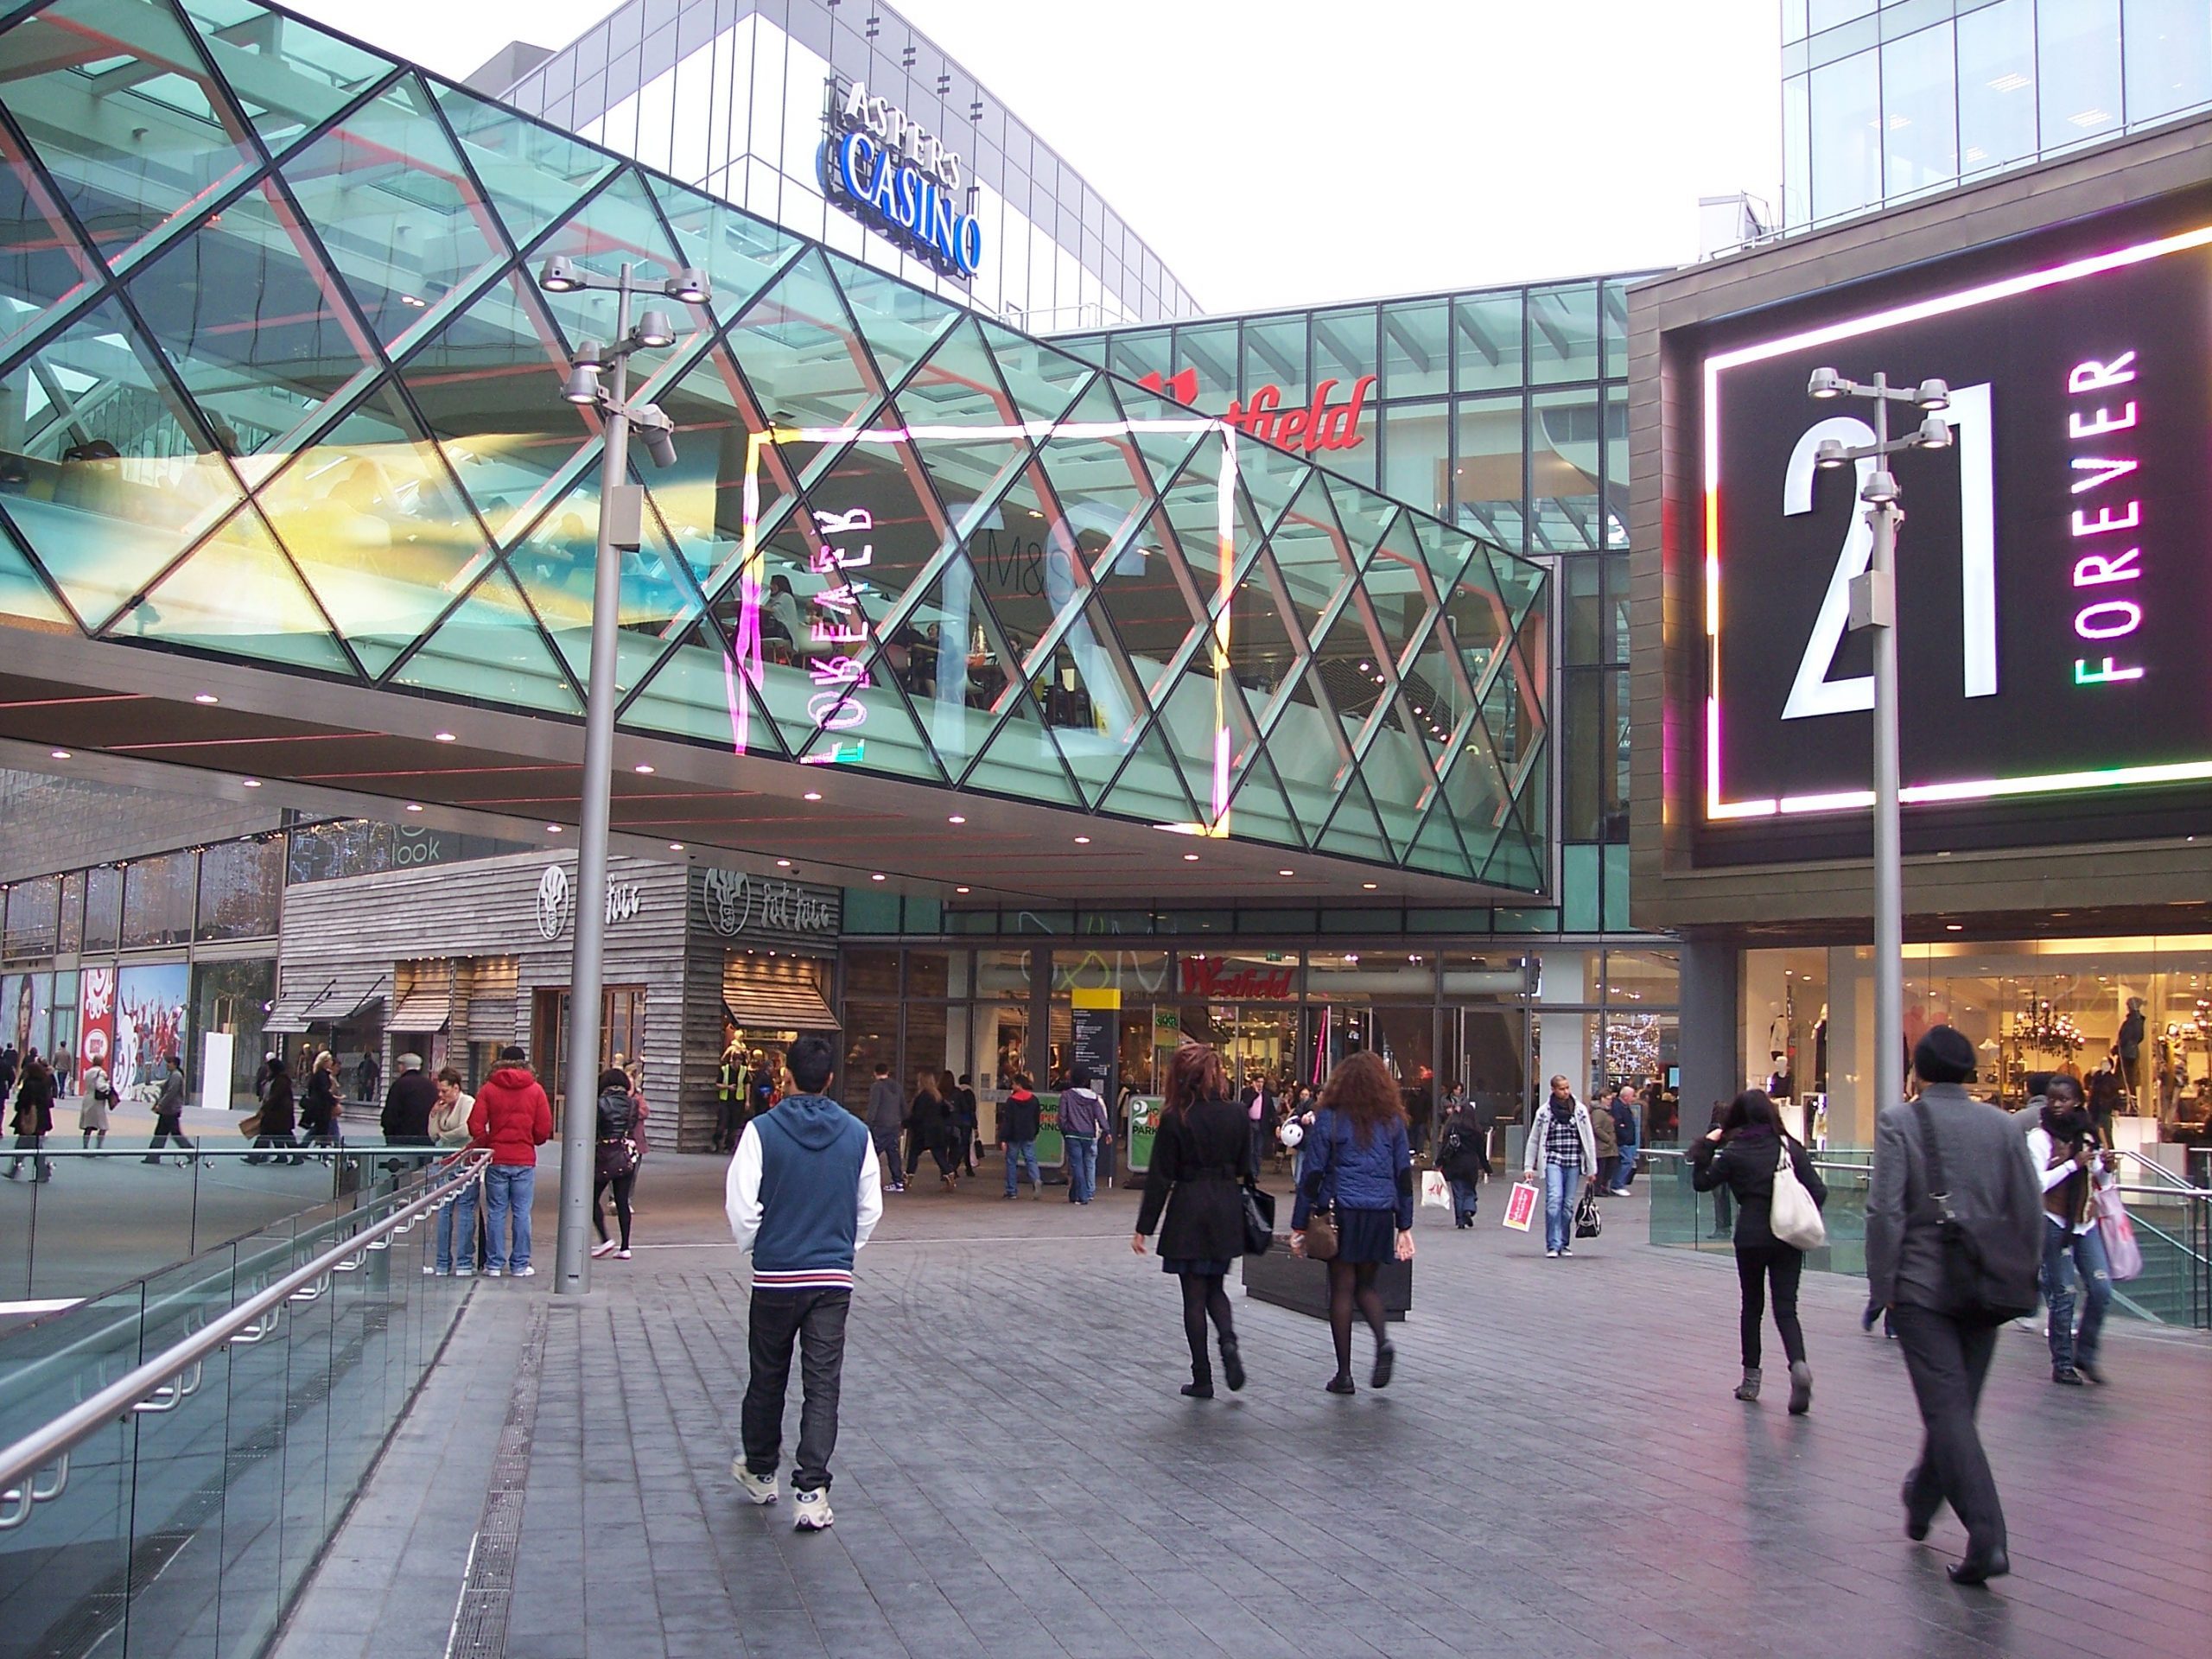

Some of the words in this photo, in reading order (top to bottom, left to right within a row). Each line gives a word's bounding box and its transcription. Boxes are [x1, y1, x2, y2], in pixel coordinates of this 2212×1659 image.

[844, 81, 961, 191] ASPERS
[840, 132, 981, 274] CASINO
[1781, 383, 1998, 720] 21
[2069, 351, 2144, 684] FOREVER
[987, 529, 1072, 606] M&S
[391, 836, 440, 866] look
[1179, 956, 1294, 1001] Westfield
[1133, 1100, 1148, 1125] 2
[1133, 1126, 1158, 1135] PARK
